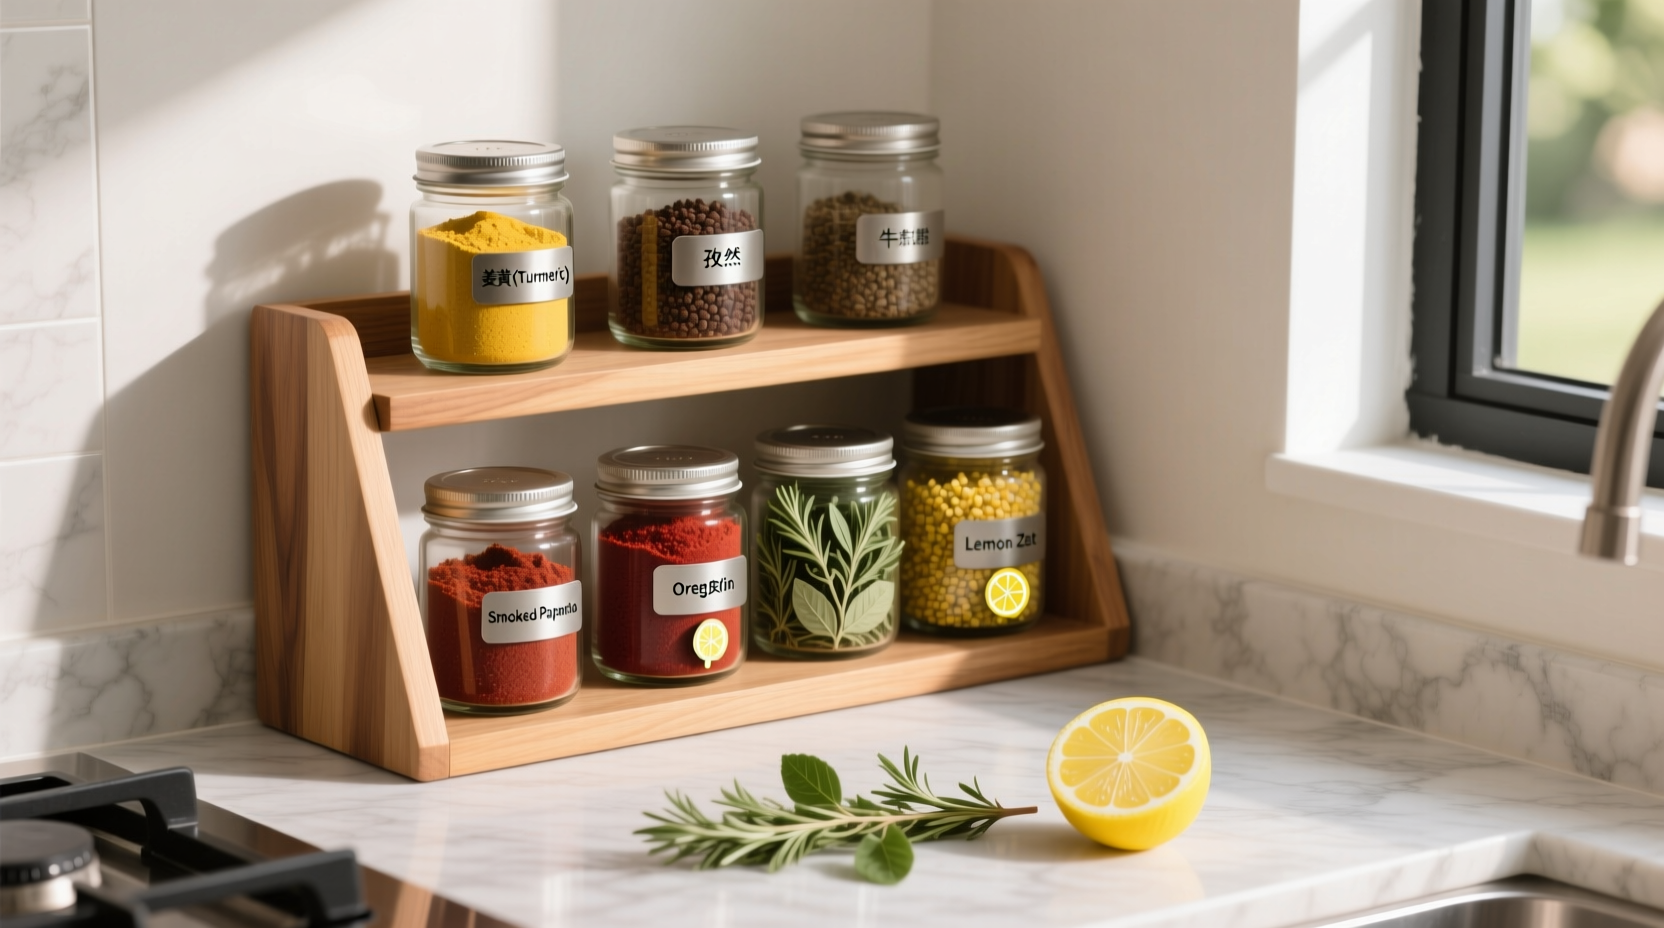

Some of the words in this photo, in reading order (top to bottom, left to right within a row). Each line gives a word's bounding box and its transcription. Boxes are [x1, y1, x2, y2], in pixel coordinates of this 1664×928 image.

[703, 246, 742, 269] 孜然
[965, 536, 1013, 551] Lemon
[488, 607, 538, 624] Smoked
